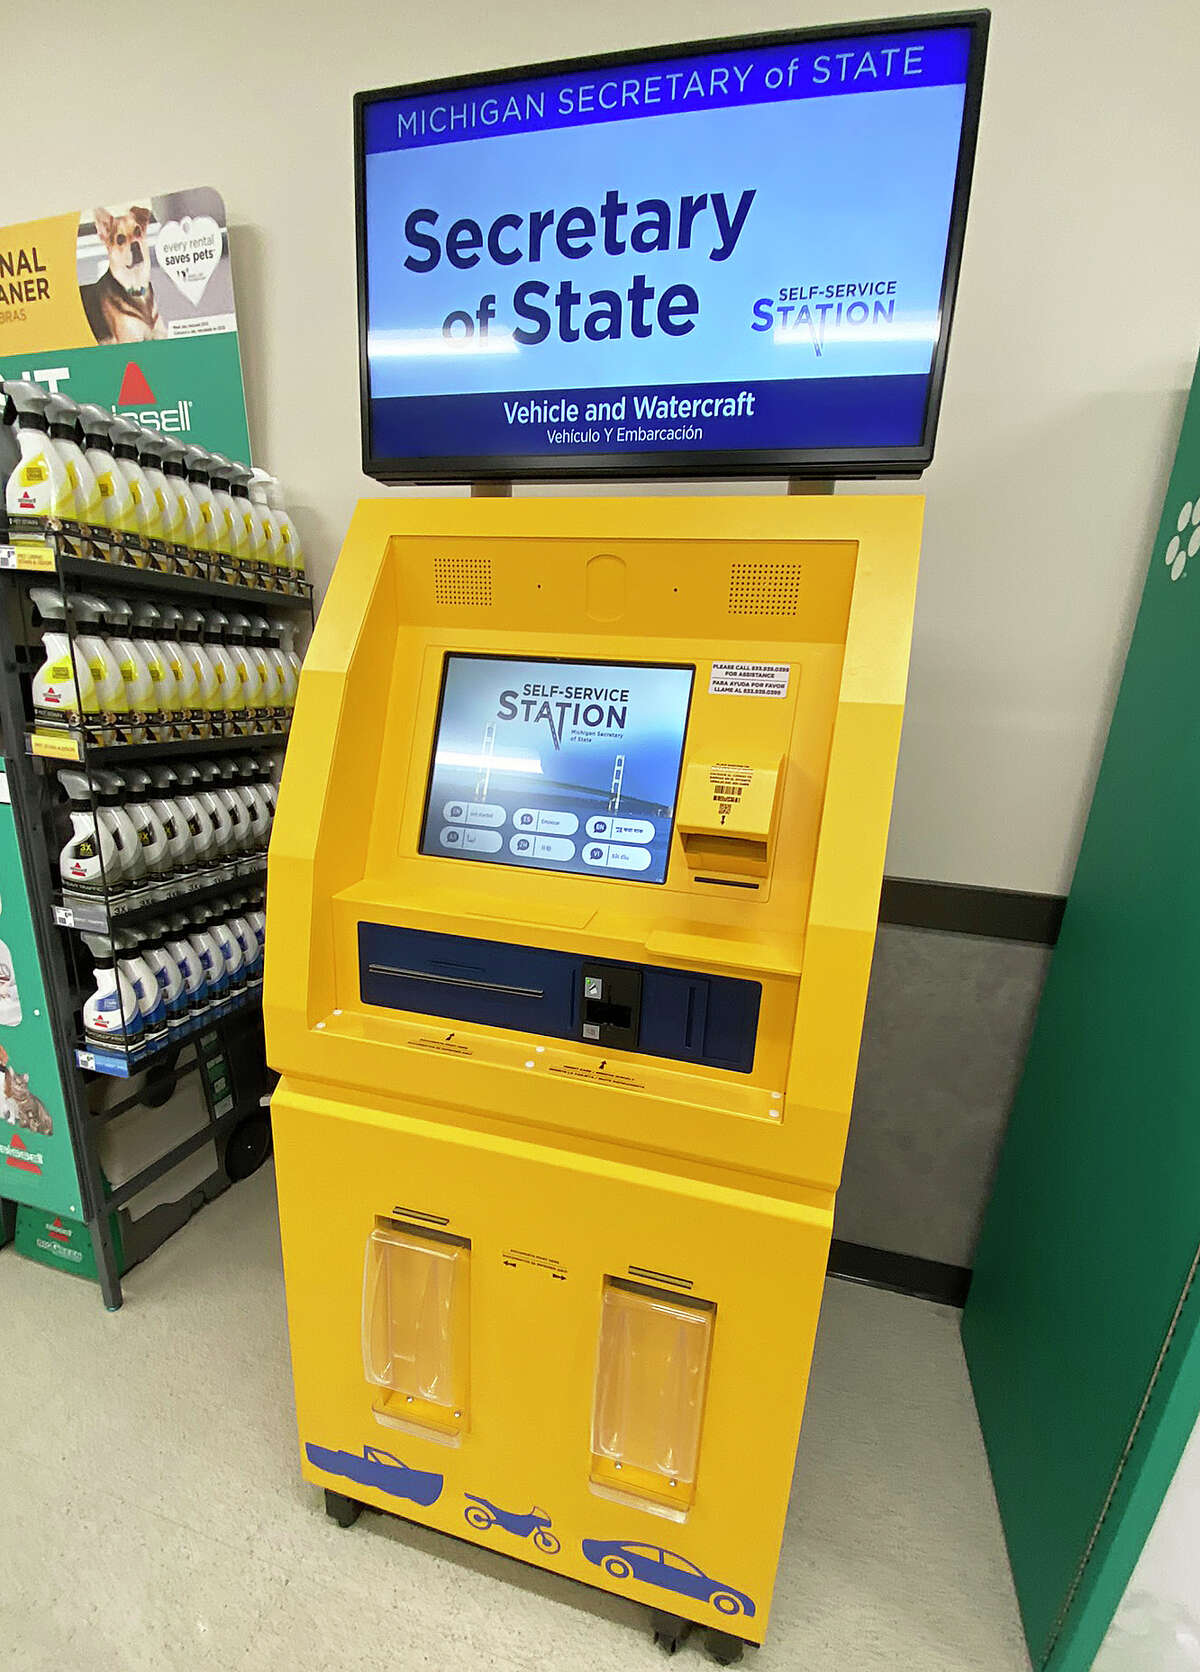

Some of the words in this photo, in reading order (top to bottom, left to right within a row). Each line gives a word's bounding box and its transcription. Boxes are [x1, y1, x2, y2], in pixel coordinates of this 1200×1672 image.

[397, 91, 545, 139] MICHIGAN
[558, 63, 754, 115] SECRETARY
[764, 57, 800, 89] of
[811, 45, 925, 84] STATE
[403, 188, 757, 274] Secretary
[163, 241, 187, 253] every
[189, 233, 215, 249] rental
[165, 252, 191, 266] saves
[778, 280, 898, 301] SELF-SERVICE
[441, 293, 497, 348] of
[512, 274, 700, 346] State
[750, 298, 896, 357] STATION
[503, 398, 580, 425] Vehicle
[584, 396, 626, 421] and
[633, 391, 756, 420] Watercraft
[546, 427, 600, 444] Vehículo
[603, 427, 614, 442] Y
[616, 424, 703, 443] Embarcación
[712, 663, 735, 671] PLEASE
[739, 671, 776, 679] ASSISTANCE
[522, 683, 630, 703] SELF-SERVICE
[496, 689, 628, 752] STATION
[79, 843, 92, 852] 3X
